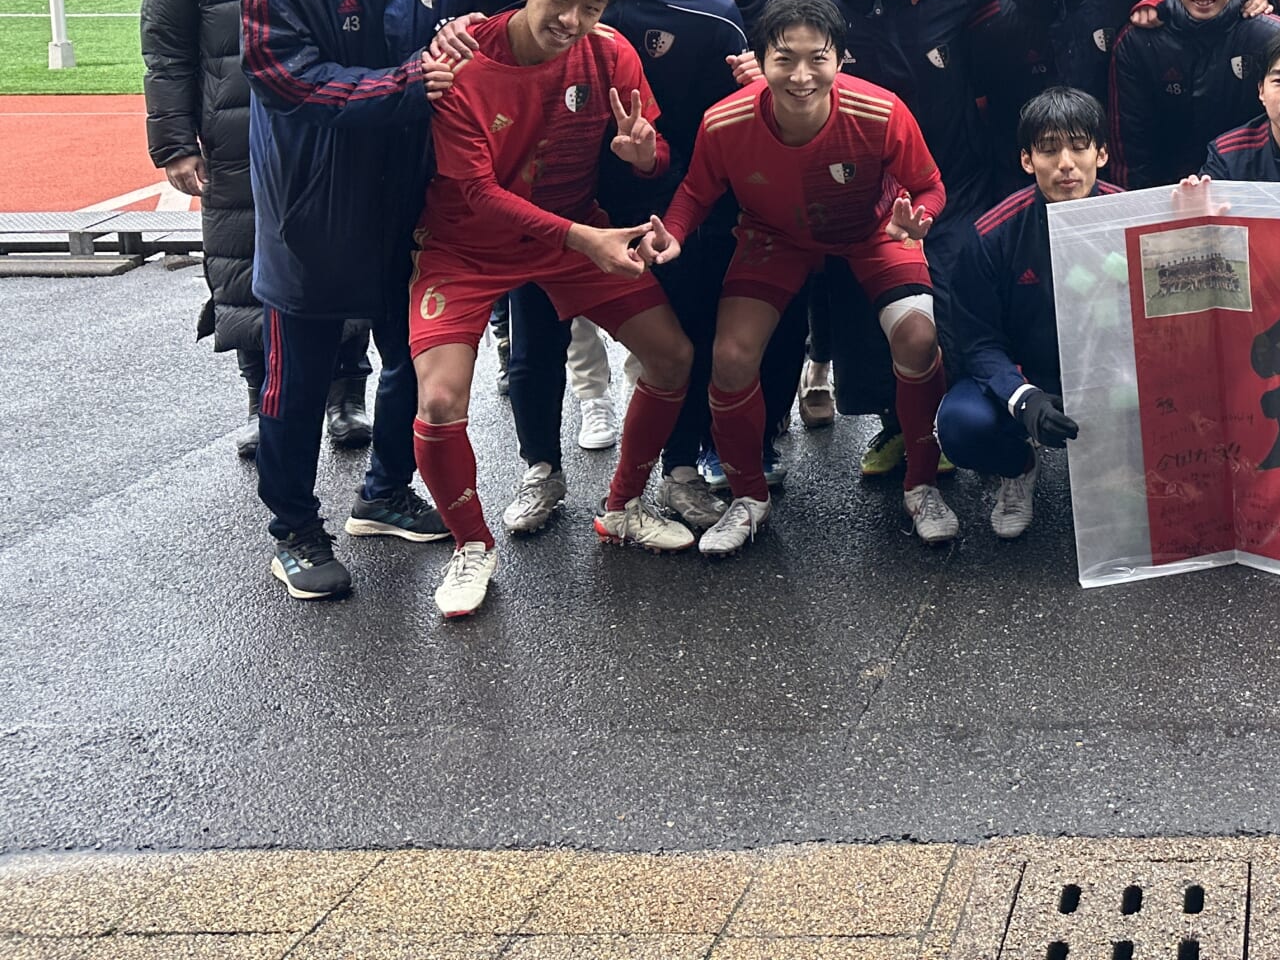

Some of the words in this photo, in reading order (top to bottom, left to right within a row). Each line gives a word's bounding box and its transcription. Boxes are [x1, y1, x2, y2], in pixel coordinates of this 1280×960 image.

[342, 15, 360, 32] 43
[1166, 83, 1181, 95] 48
[420, 287, 446, 320] 6
